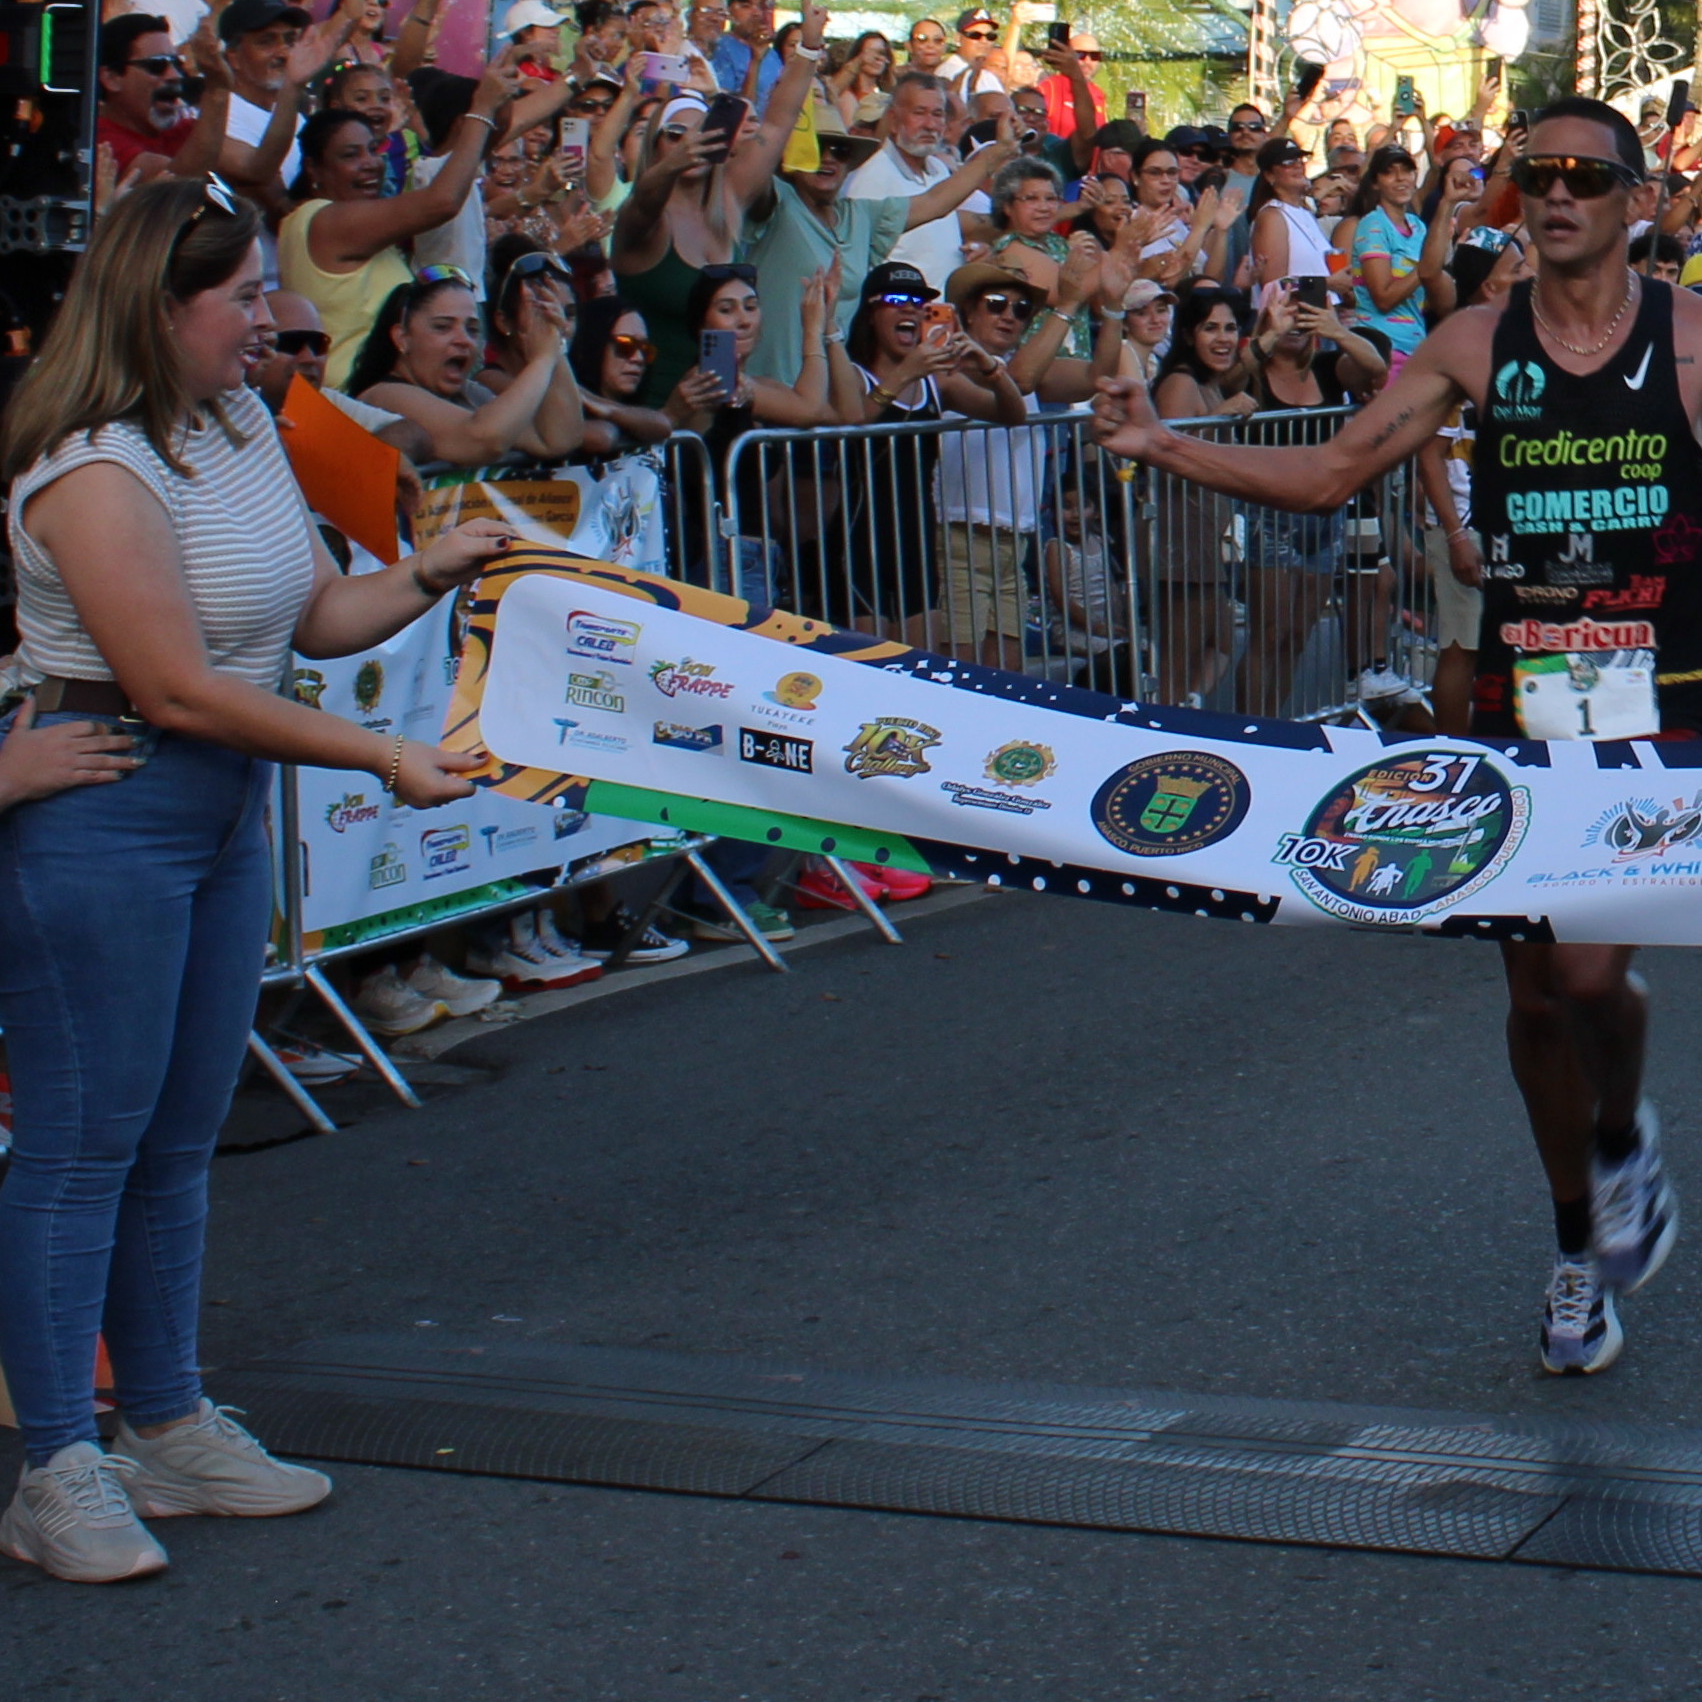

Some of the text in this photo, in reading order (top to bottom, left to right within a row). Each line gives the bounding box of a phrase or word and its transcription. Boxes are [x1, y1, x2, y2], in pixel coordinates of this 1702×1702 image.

[1500, 429, 1667, 467] Credicentro
[1620, 463, 1662, 481] coop
[1506, 485, 1669, 522] COMERCIO
[1512, 520, 1564, 534] CASH
[1591, 515, 1664, 532] CARRY
[577, 635, 617, 652] CALEB
[1525, 619, 1650, 648] Boricua
[669, 674, 736, 699] FRAPPE
[751, 704, 816, 726] YUKAYEKE
[1576, 698, 1596, 735] 1
[1128, 753, 1241, 786] GOBIERNO MUNICIPAL
[1408, 754, 1481, 794] 31
[1129, 844, 1175, 855] PUERTO
[1177, 842, 1204, 854] RICO
[1277, 835, 1360, 872] 10K
[1294, 869, 1313, 890] SAN
[1310, 886, 1376, 923] ANTONIO
[1378, 910, 1422, 924] ABAD
[1493, 819, 1526, 867] PUERTO
[1513, 789, 1526, 817] RICO
[1526, 866, 1617, 885] BLACK
[1624, 866, 1641, 877] &
